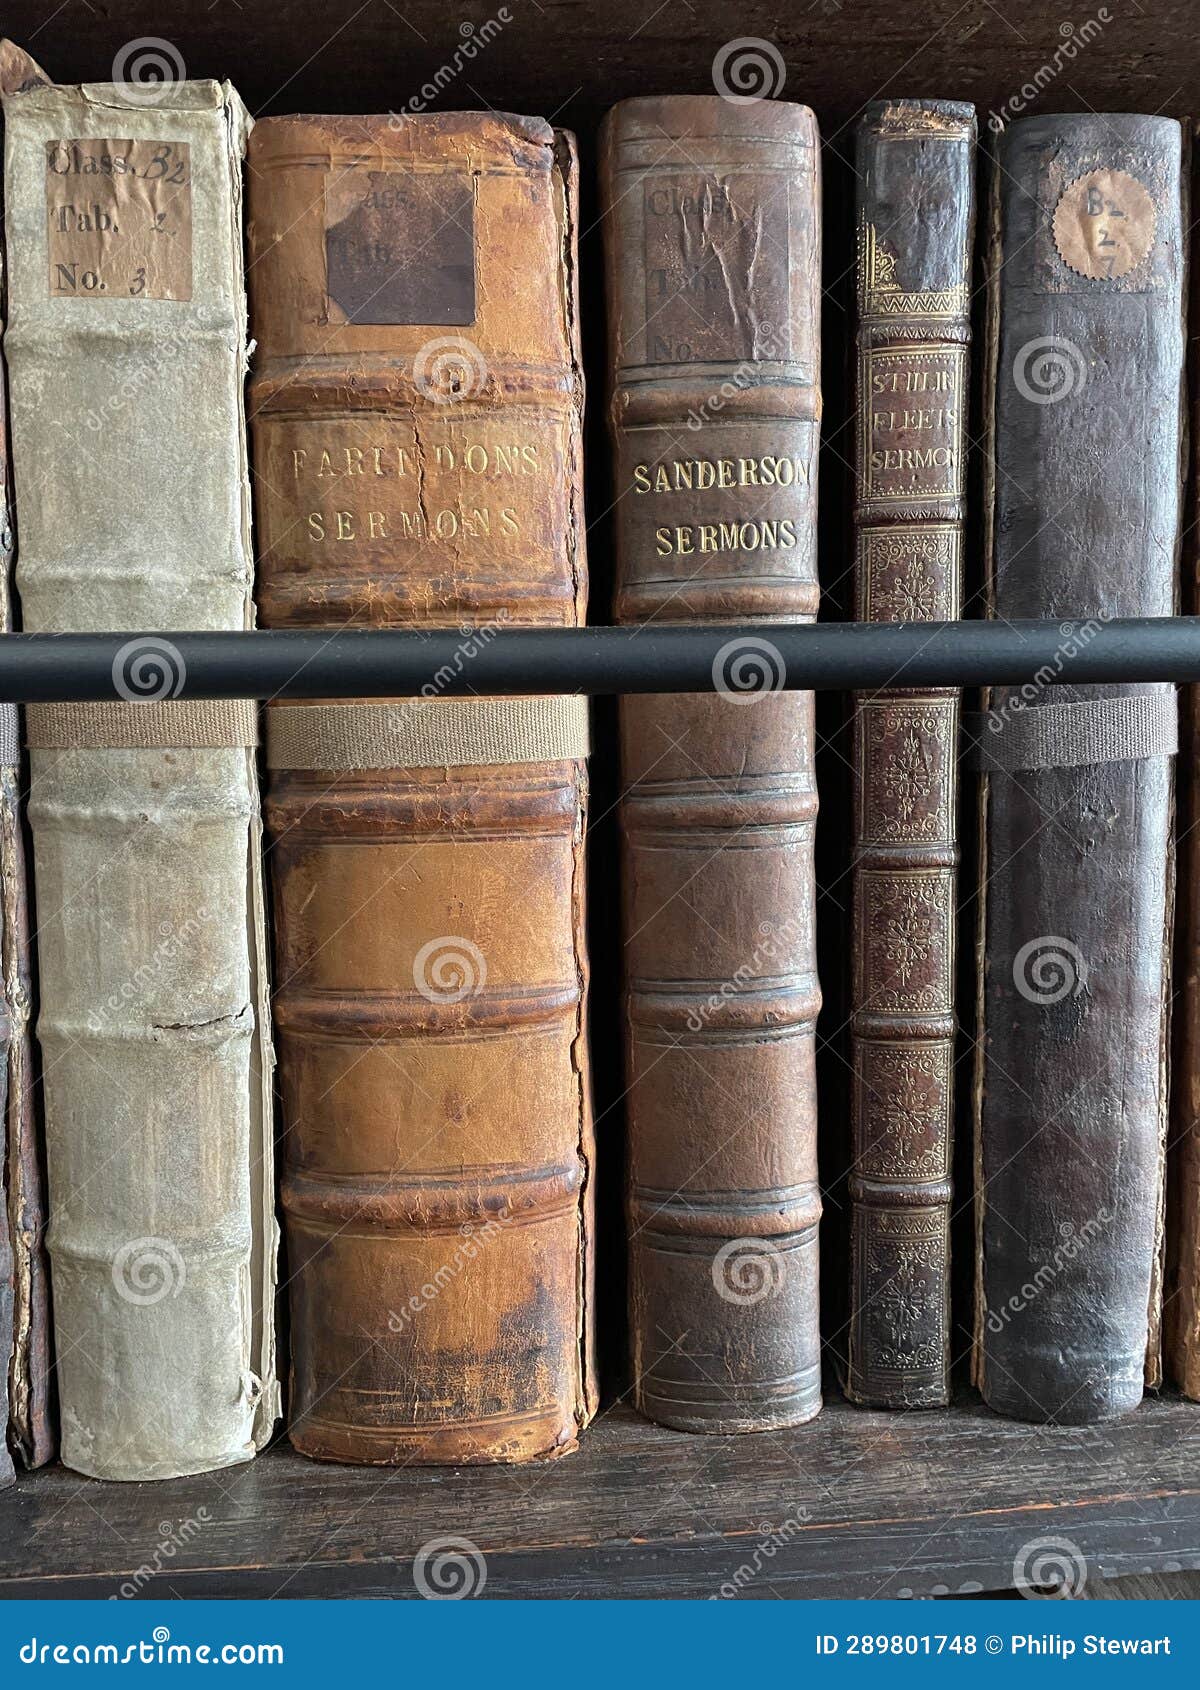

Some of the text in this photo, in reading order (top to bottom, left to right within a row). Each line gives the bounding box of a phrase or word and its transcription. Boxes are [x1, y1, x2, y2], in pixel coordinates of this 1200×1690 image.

[51, 205, 119, 233] Tab.
[55, 263, 147, 295] No. 3
[634, 456, 809, 494] SANDERSON
[308, 507, 521, 542] SERMONS
[656, 519, 797, 556] SERMONS
